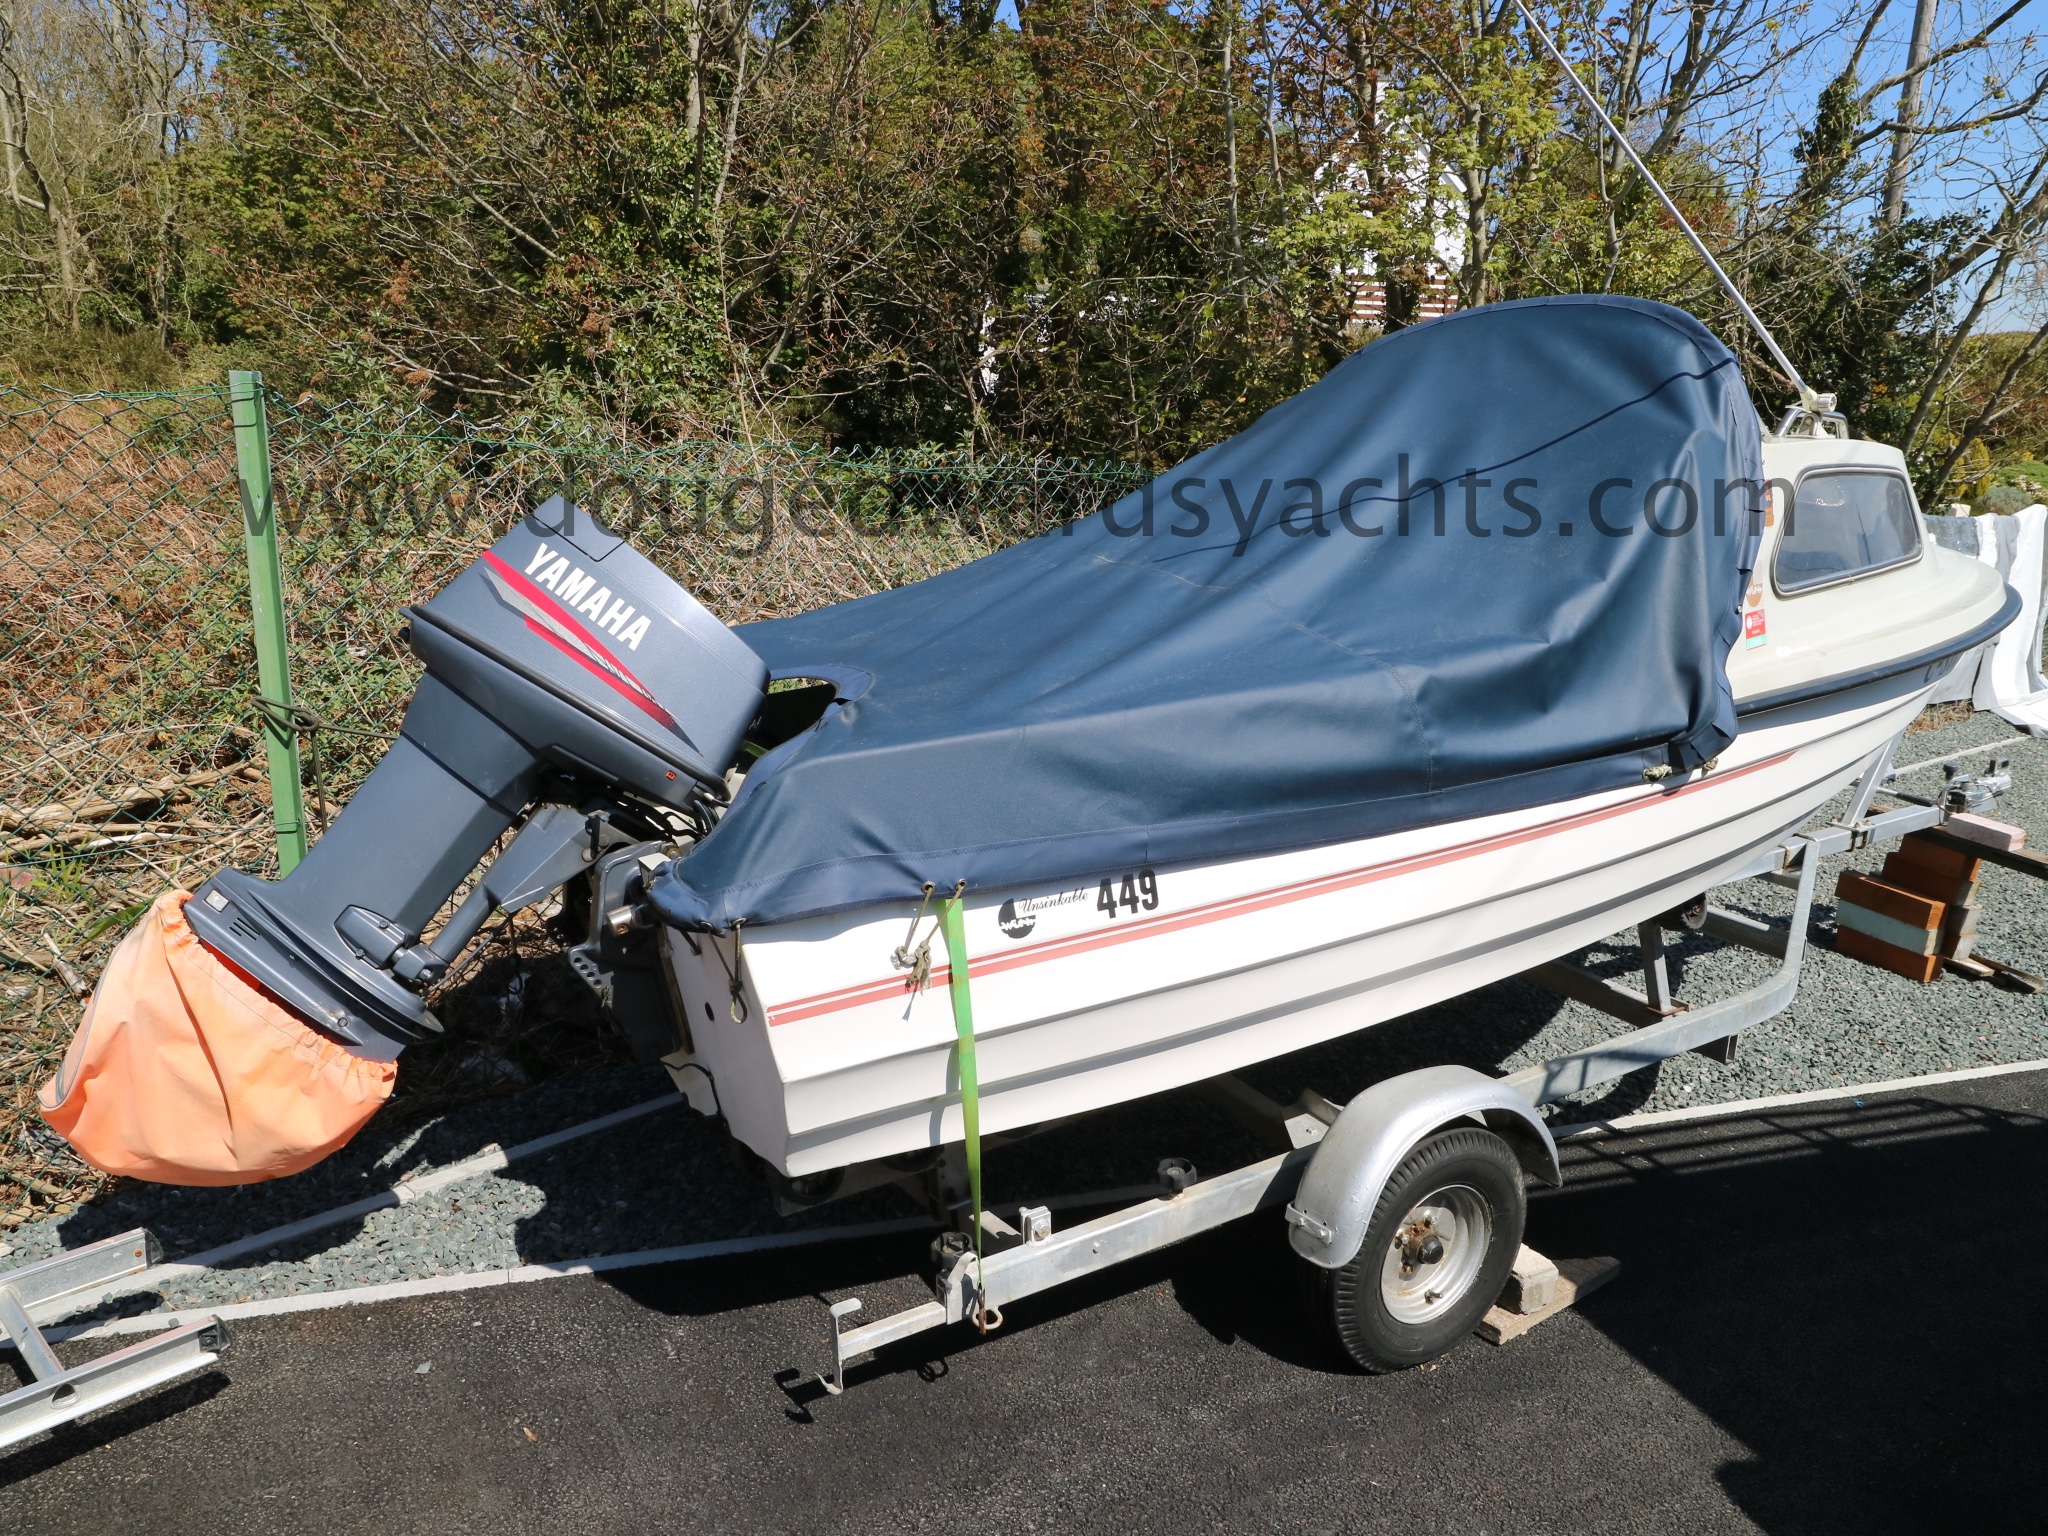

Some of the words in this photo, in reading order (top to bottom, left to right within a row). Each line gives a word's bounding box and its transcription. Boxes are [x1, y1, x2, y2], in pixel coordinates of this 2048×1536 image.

[524, 542, 652, 651] YAMAHA
[1018, 886, 1089, 913] Unsinkable
[1096, 868, 1159, 919] 449
